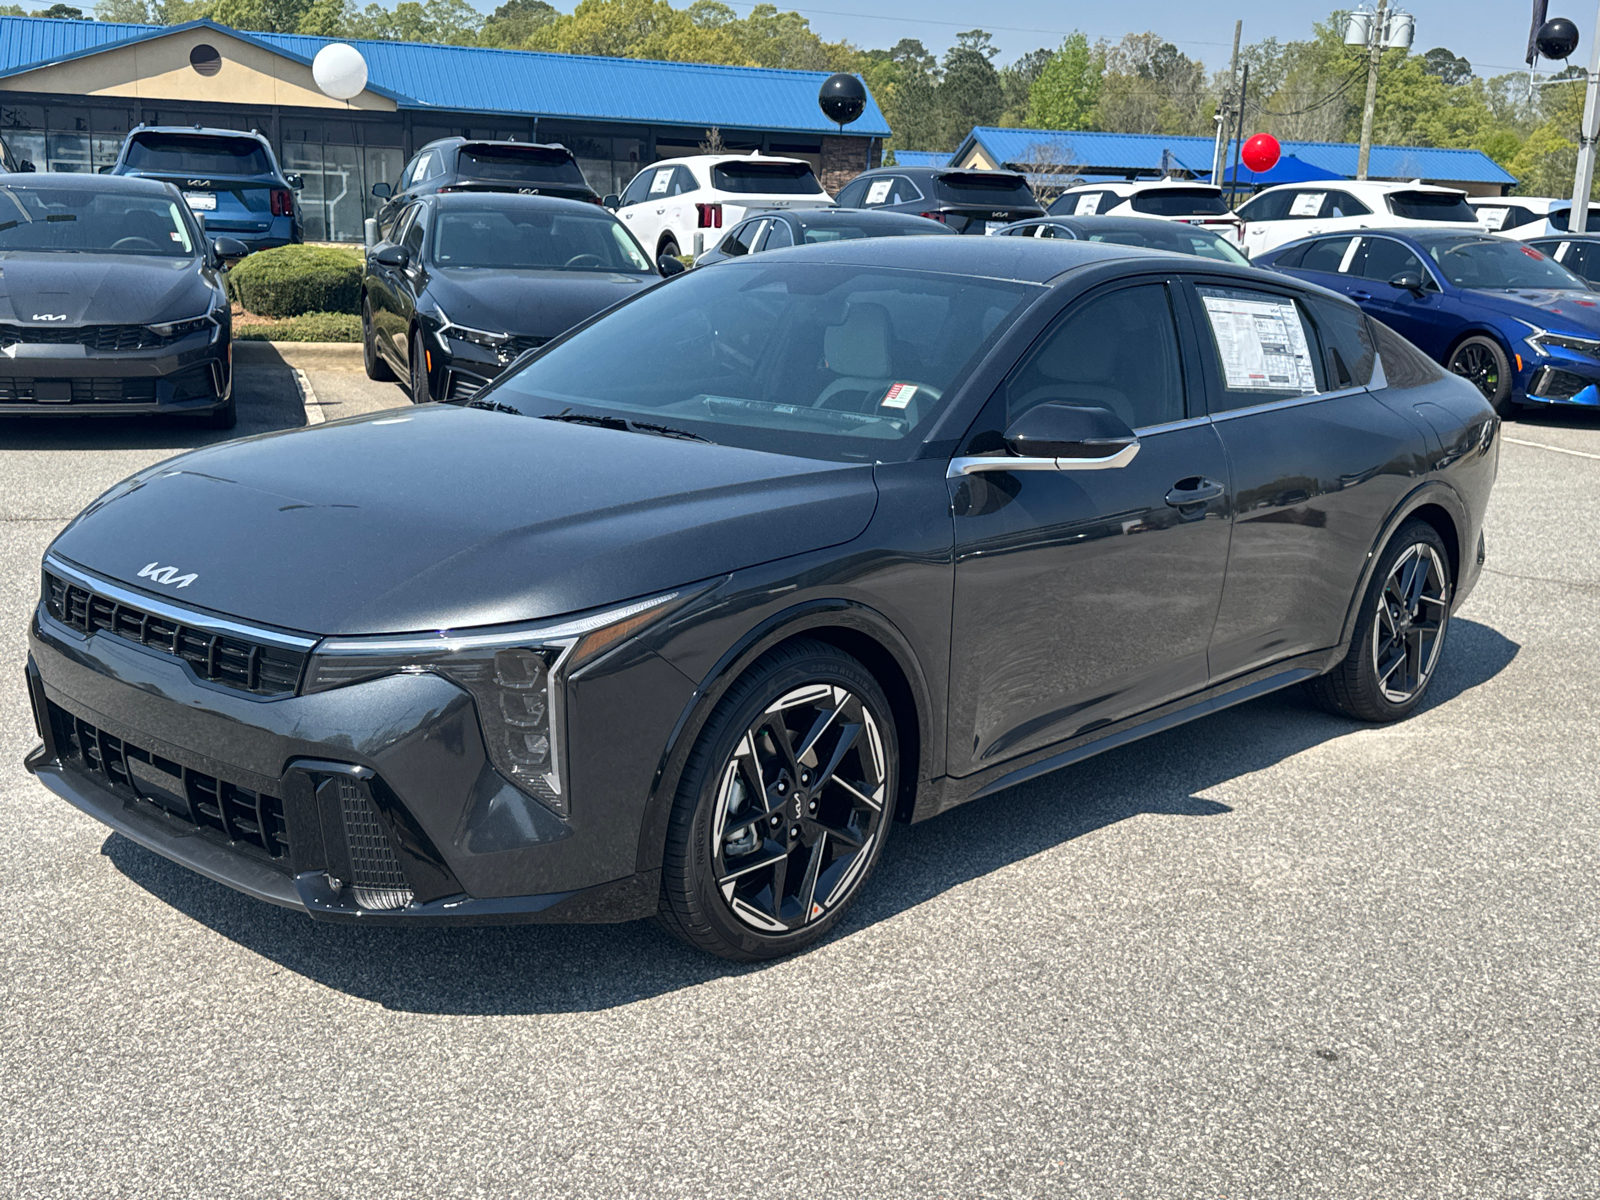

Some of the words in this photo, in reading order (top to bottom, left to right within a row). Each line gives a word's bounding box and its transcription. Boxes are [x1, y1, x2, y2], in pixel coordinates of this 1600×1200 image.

[187, 179, 211, 187] KIA
[32, 313, 67, 321] KIA
[136, 562, 199, 589] KIA
[810, 664, 839, 674] 235/40
[839, 667, 855, 679] R18
[854, 673, 870, 690] 91W
[793, 792, 802, 820] KIA
